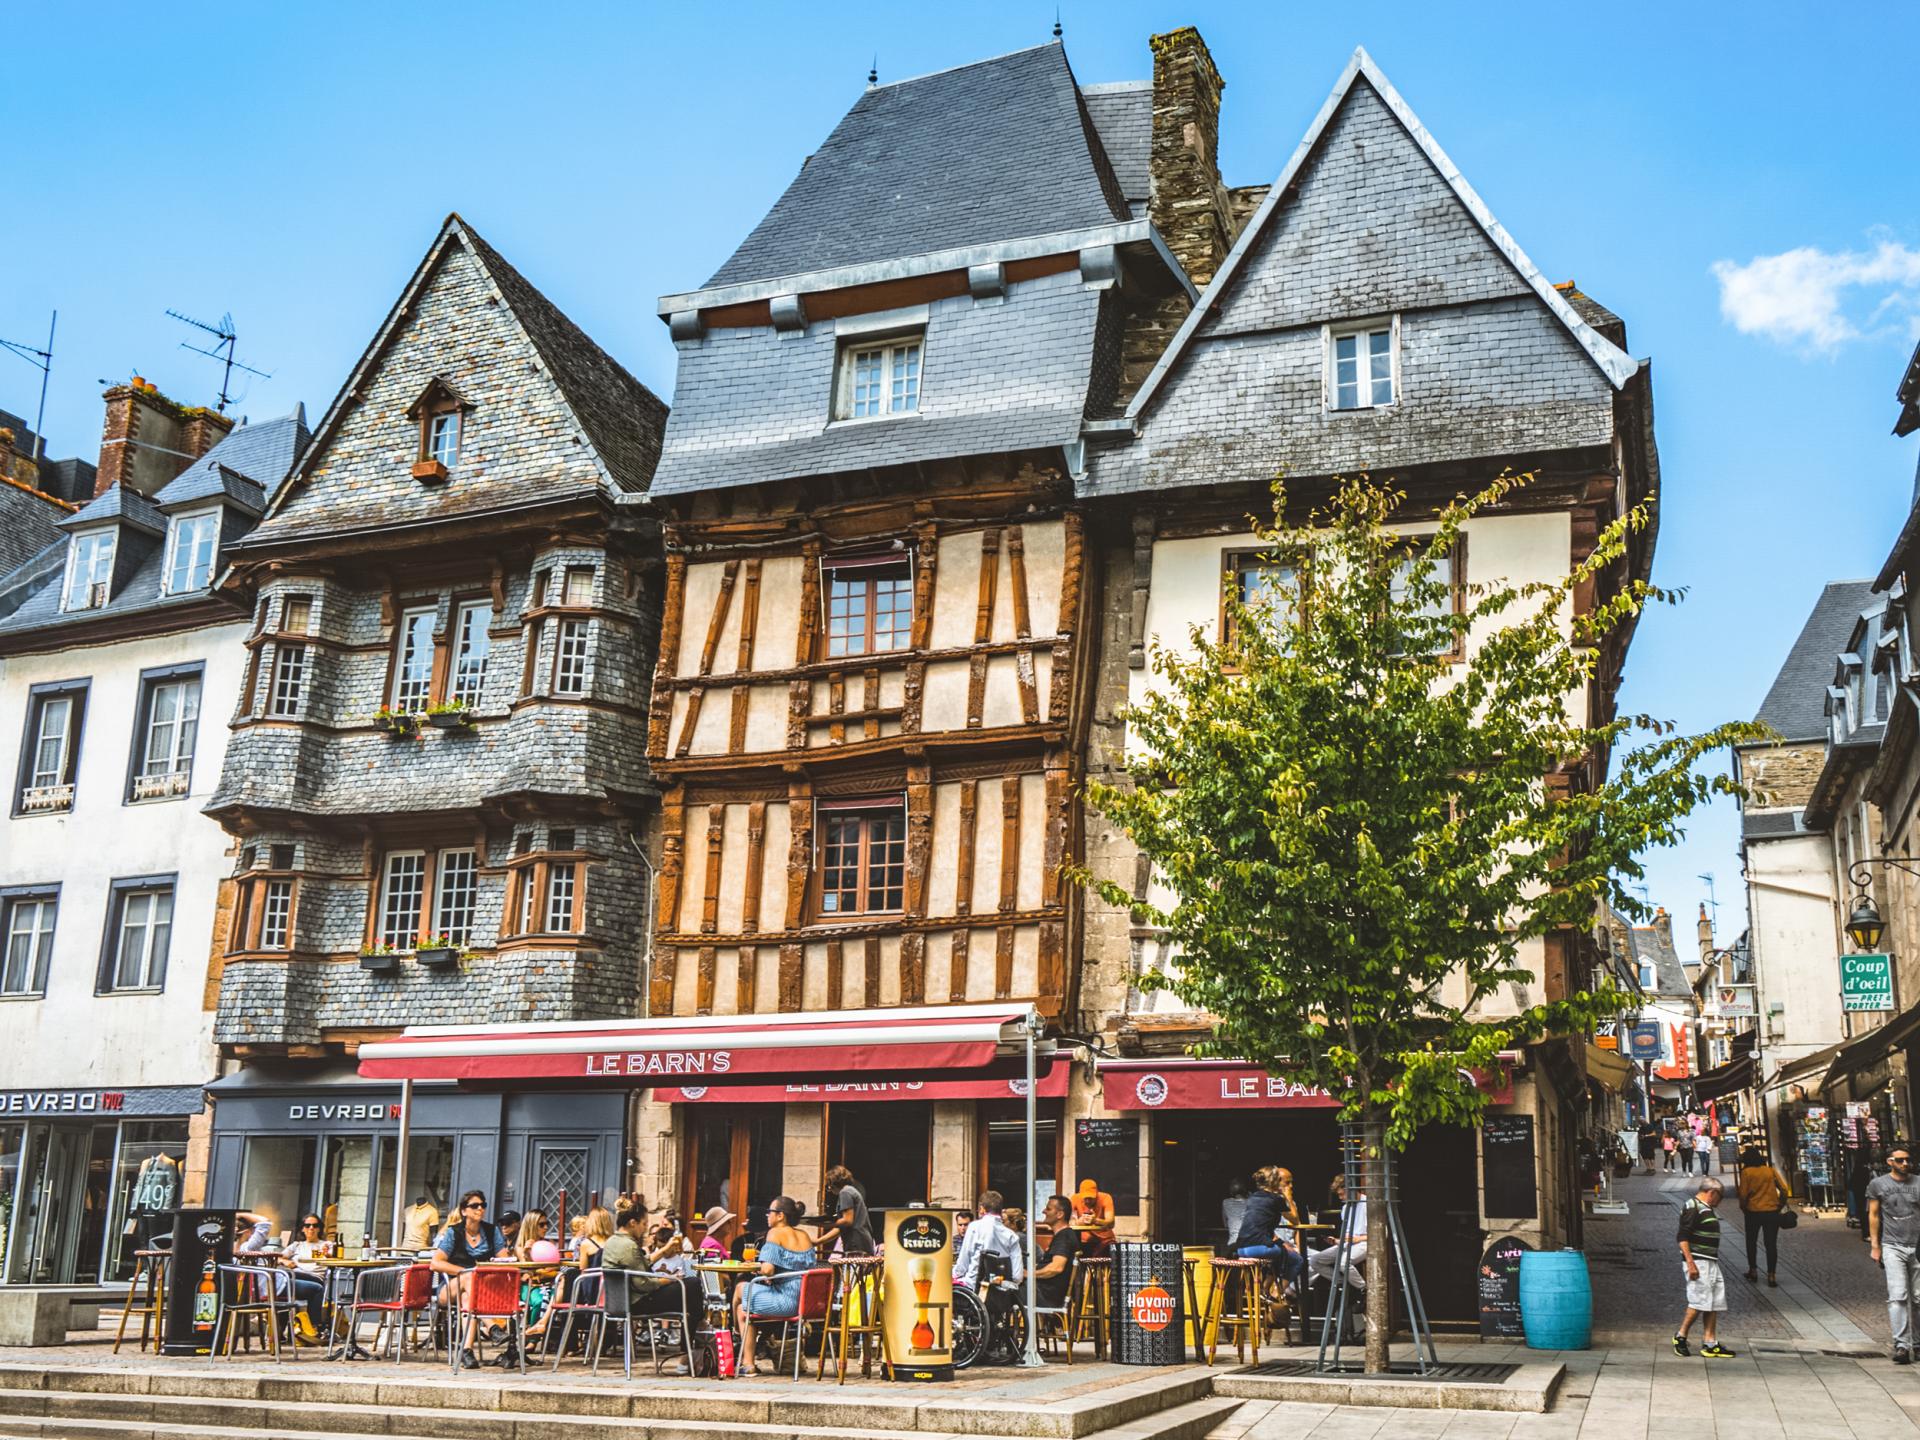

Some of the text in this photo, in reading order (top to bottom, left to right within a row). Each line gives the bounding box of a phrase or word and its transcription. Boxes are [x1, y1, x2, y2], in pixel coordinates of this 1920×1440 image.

[1845, 959, 1885, 975] Coup
[1845, 976, 1888, 990] d'oeil
[1860, 994, 1883, 1002] PRET
[586, 1051, 731, 1075] LE BARN'S
[1220, 1077, 1259, 1098] LE
[101, 1092, 124, 1111] 1902
[289, 1104, 402, 1119] DEVRED 190
[1152, 1243, 1180, 1252] CUBA
[1127, 1293, 1176, 1308] Havana
[1138, 1309, 1168, 1323] Club
